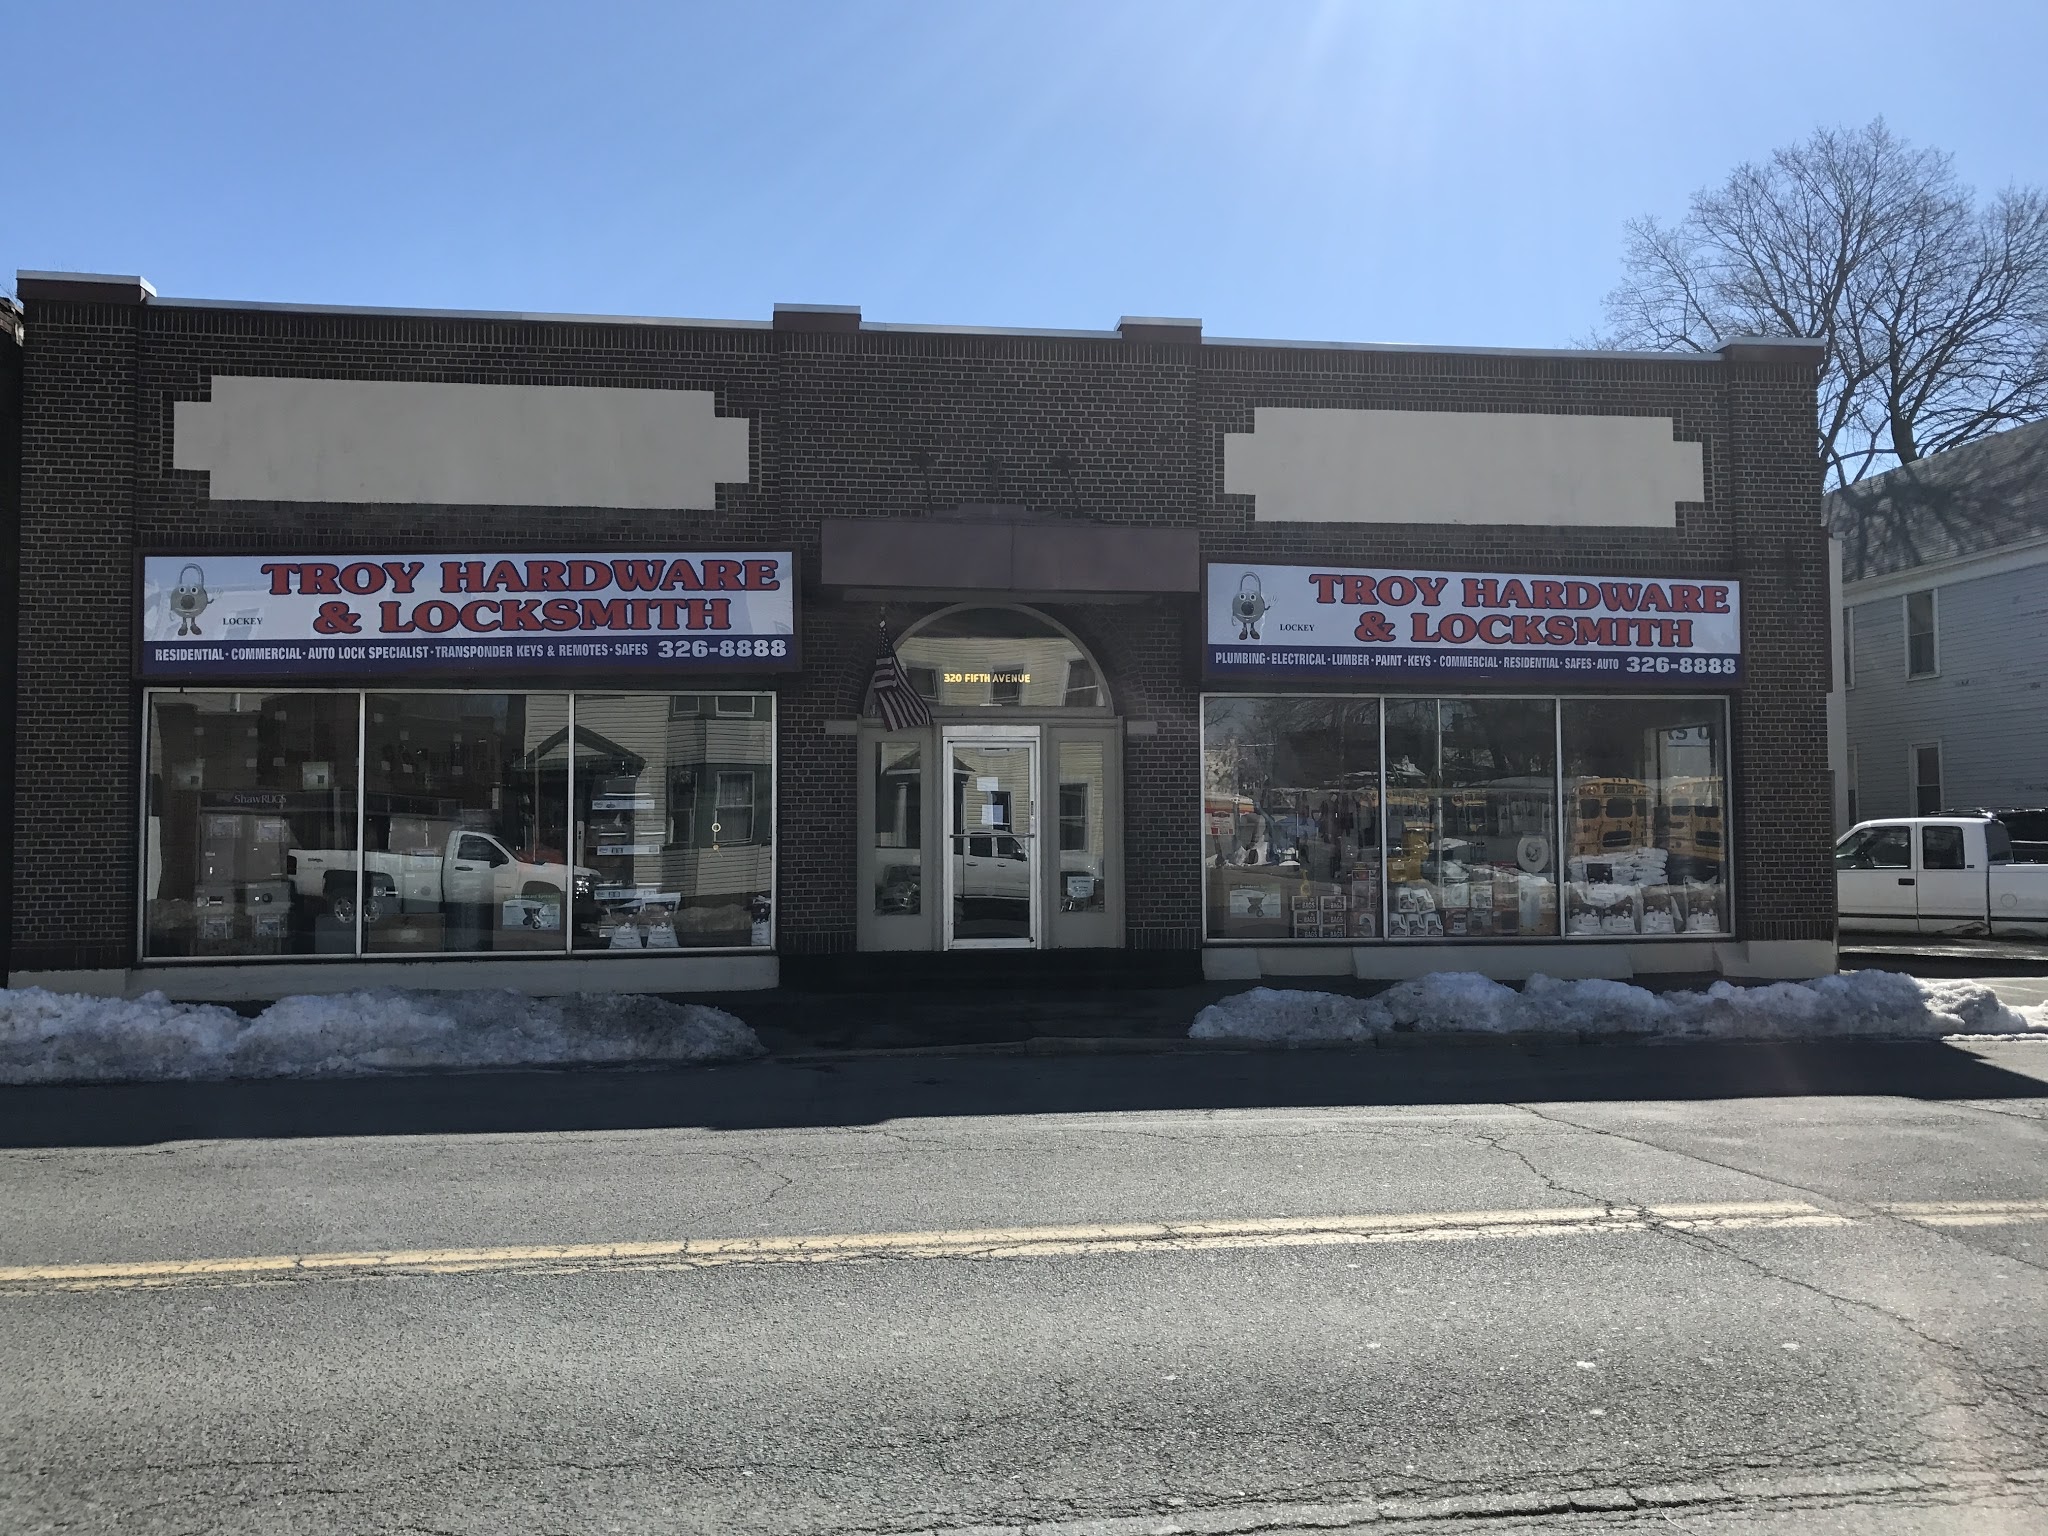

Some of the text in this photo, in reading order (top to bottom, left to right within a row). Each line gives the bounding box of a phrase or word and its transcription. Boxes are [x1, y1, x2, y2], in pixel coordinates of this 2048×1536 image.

[261, 559, 780, 595] TROY HARDWARE
[1309, 573, 1730, 614] TROY HARDWARE
[223, 617, 263, 626] LOCKEY
[313, 598, 732, 634] & LOCKSMITH
[1279, 623, 1315, 632] LOCKEY
[1354, 611, 1693, 647] & LOCKSMITH
[155, 639, 787, 661] RESIDENTIAL COMMERCIAL AUTO LOCK SPECIALIST TRANSPONDER KEYS & REMOTES SAFES 326-8888
[1215, 652, 1736, 674] PLUMBING ELECTRICAL LUMBER PAINT KEYS COMMERCIAL RESIDENTIAL SAFES AUTO 326-8888
[943, 673, 1031, 683] 320 FIFTH AVENUE
